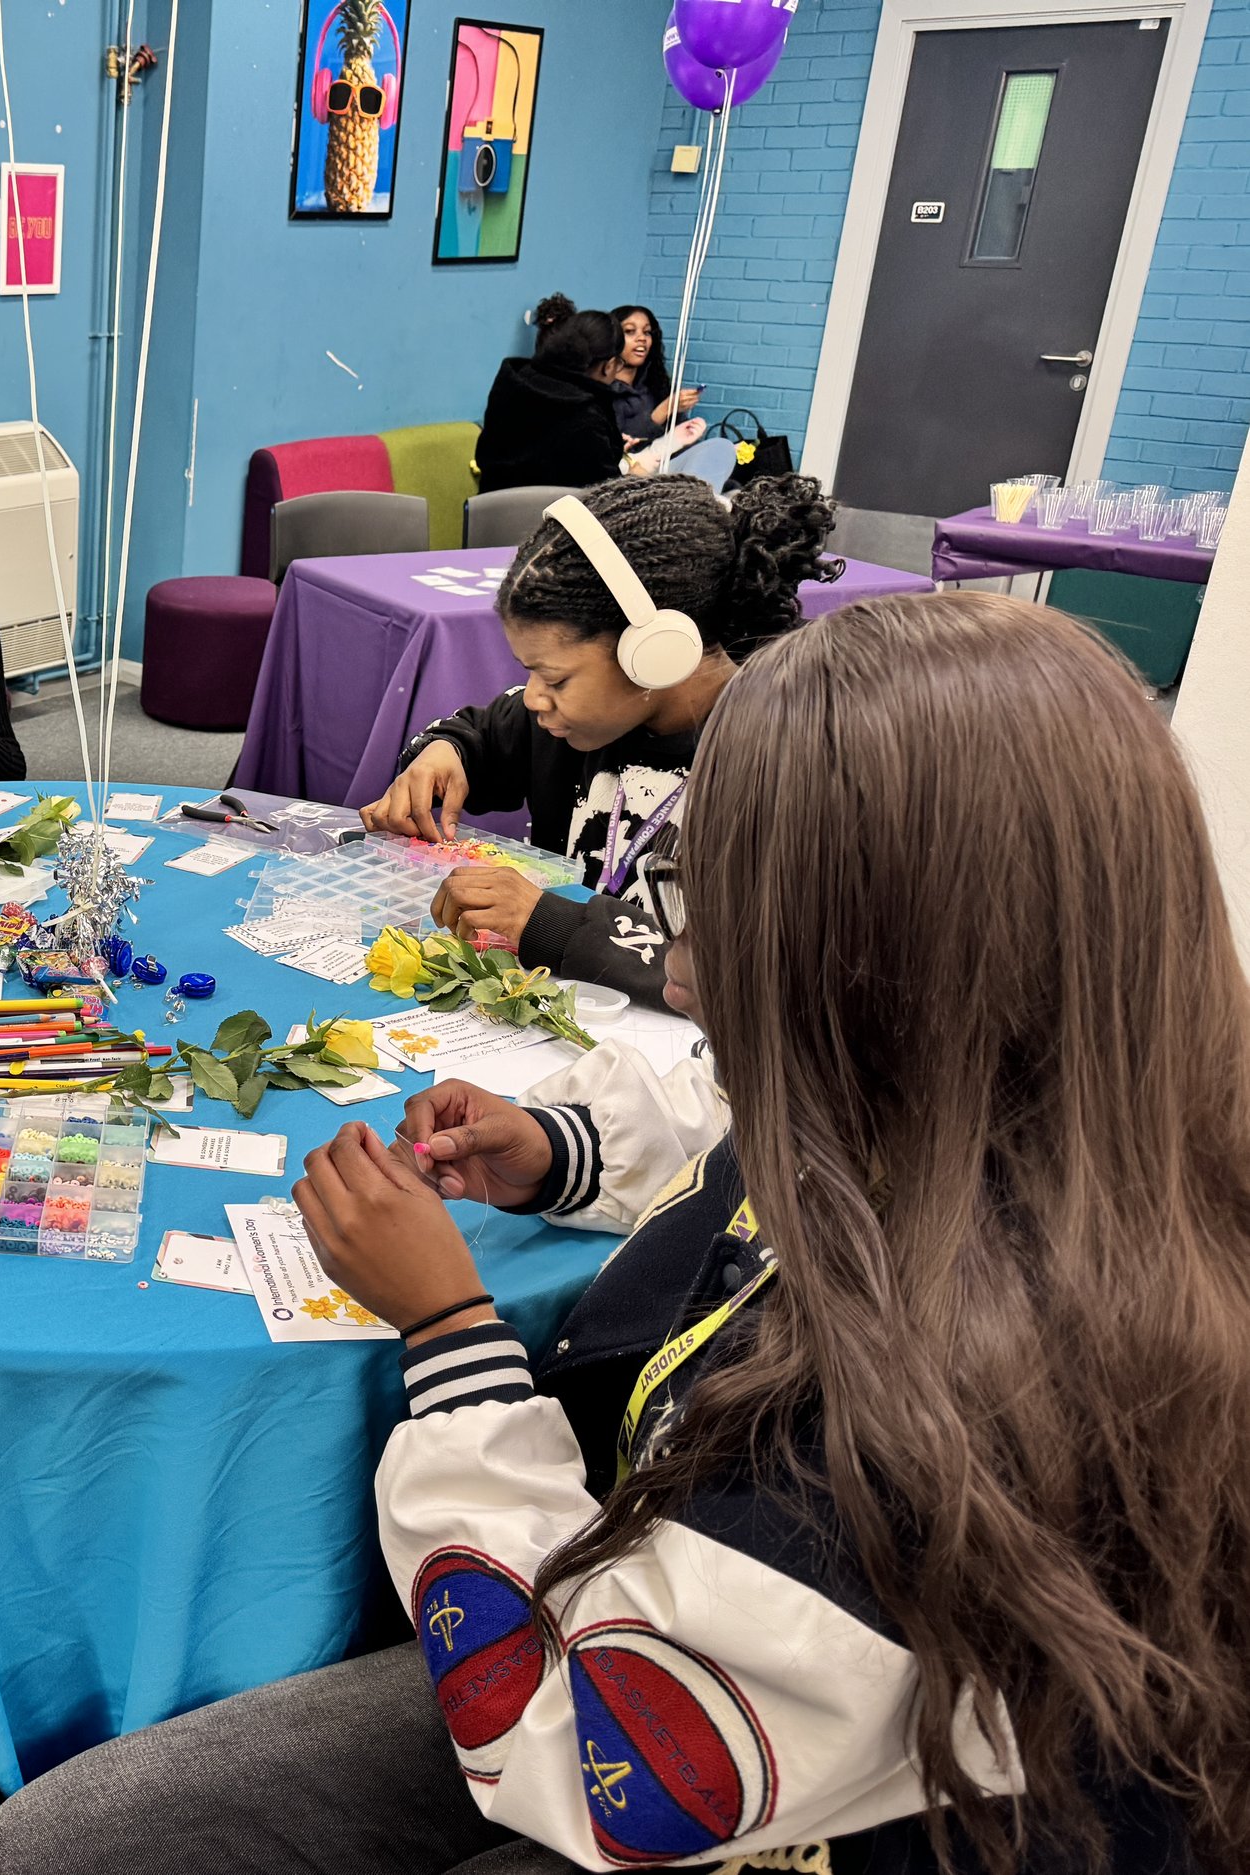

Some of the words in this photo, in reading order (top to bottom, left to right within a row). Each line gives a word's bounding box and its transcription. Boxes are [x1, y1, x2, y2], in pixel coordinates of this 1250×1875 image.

[917, 206, 938, 214] B203
[26, 216, 53, 239] YOU
[651, 795, 678, 826] DANCE
[604, 830, 614, 868] NEWVIC
[610, 794, 622, 827] DANCE
[623, 825, 655, 869] COMPANY
[245, 1218, 256, 1231] Day
[248, 1232, 267, 1263] Women's
[271, 1244, 280, 1255] hard
[276, 1255, 286, 1266] your
[262, 1262, 284, 1306] International
[286, 1279, 295, 1288] you
[289, 1288, 298, 1303] Thank
[640, 1333, 695, 1393] STUDENT
[593, 1650, 736, 1826] BASKETBALL
